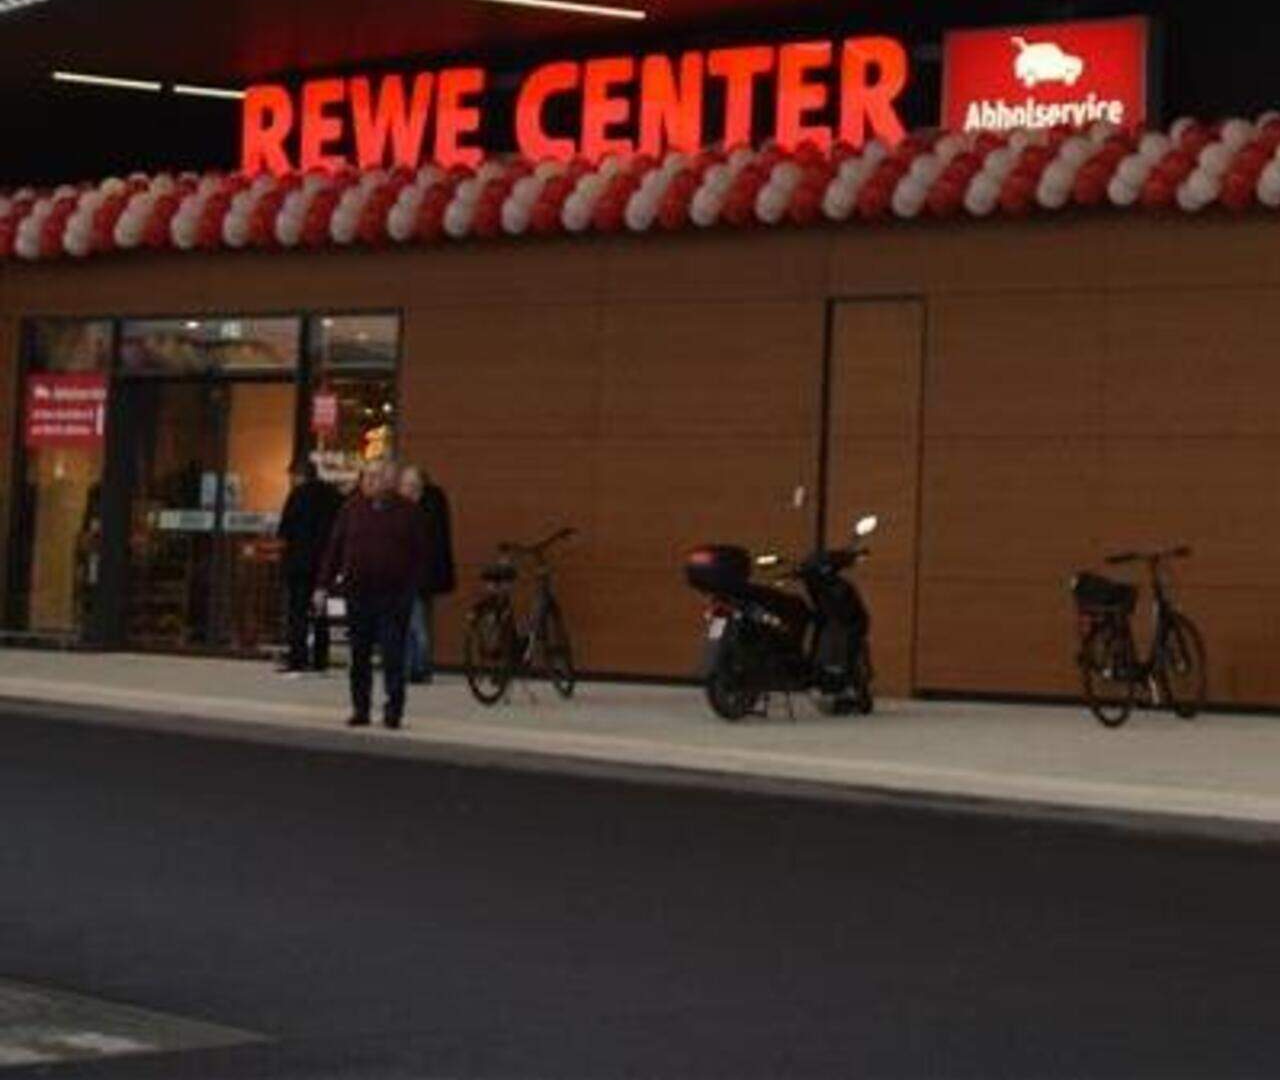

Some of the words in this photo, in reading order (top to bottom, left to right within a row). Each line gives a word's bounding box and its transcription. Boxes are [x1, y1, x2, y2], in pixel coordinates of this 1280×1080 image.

[243, 67, 485, 178] REWE
[515, 35, 907, 166] CENTER
[964, 92, 1124, 133] Abholservice
